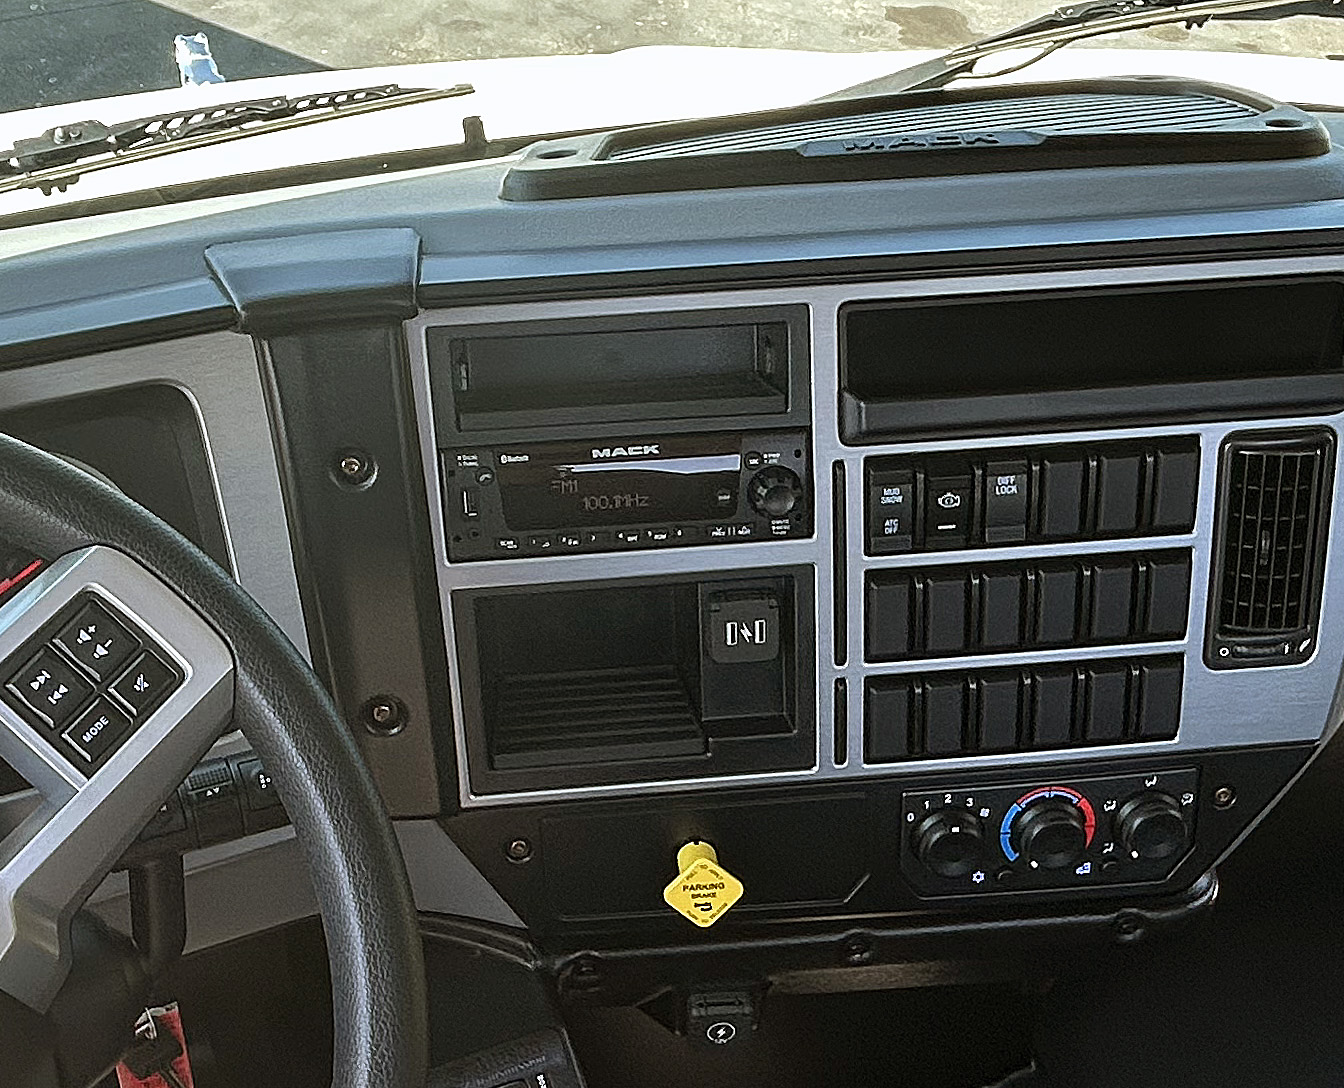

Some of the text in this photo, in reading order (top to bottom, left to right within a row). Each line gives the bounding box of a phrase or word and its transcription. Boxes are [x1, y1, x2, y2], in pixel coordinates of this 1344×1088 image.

[844, 133, 999, 150] MACK
[592, 445, 659, 459] MACK
[995, 485, 1017, 495] LOCK
[82, 715, 110, 743] MODE
[945, 794, 951, 803] 2
[966, 798, 973, 807] 3
[924, 801, 929, 809] 1
[907, 813, 914, 822] 0
[683, 882, 725, 892] PARKING
